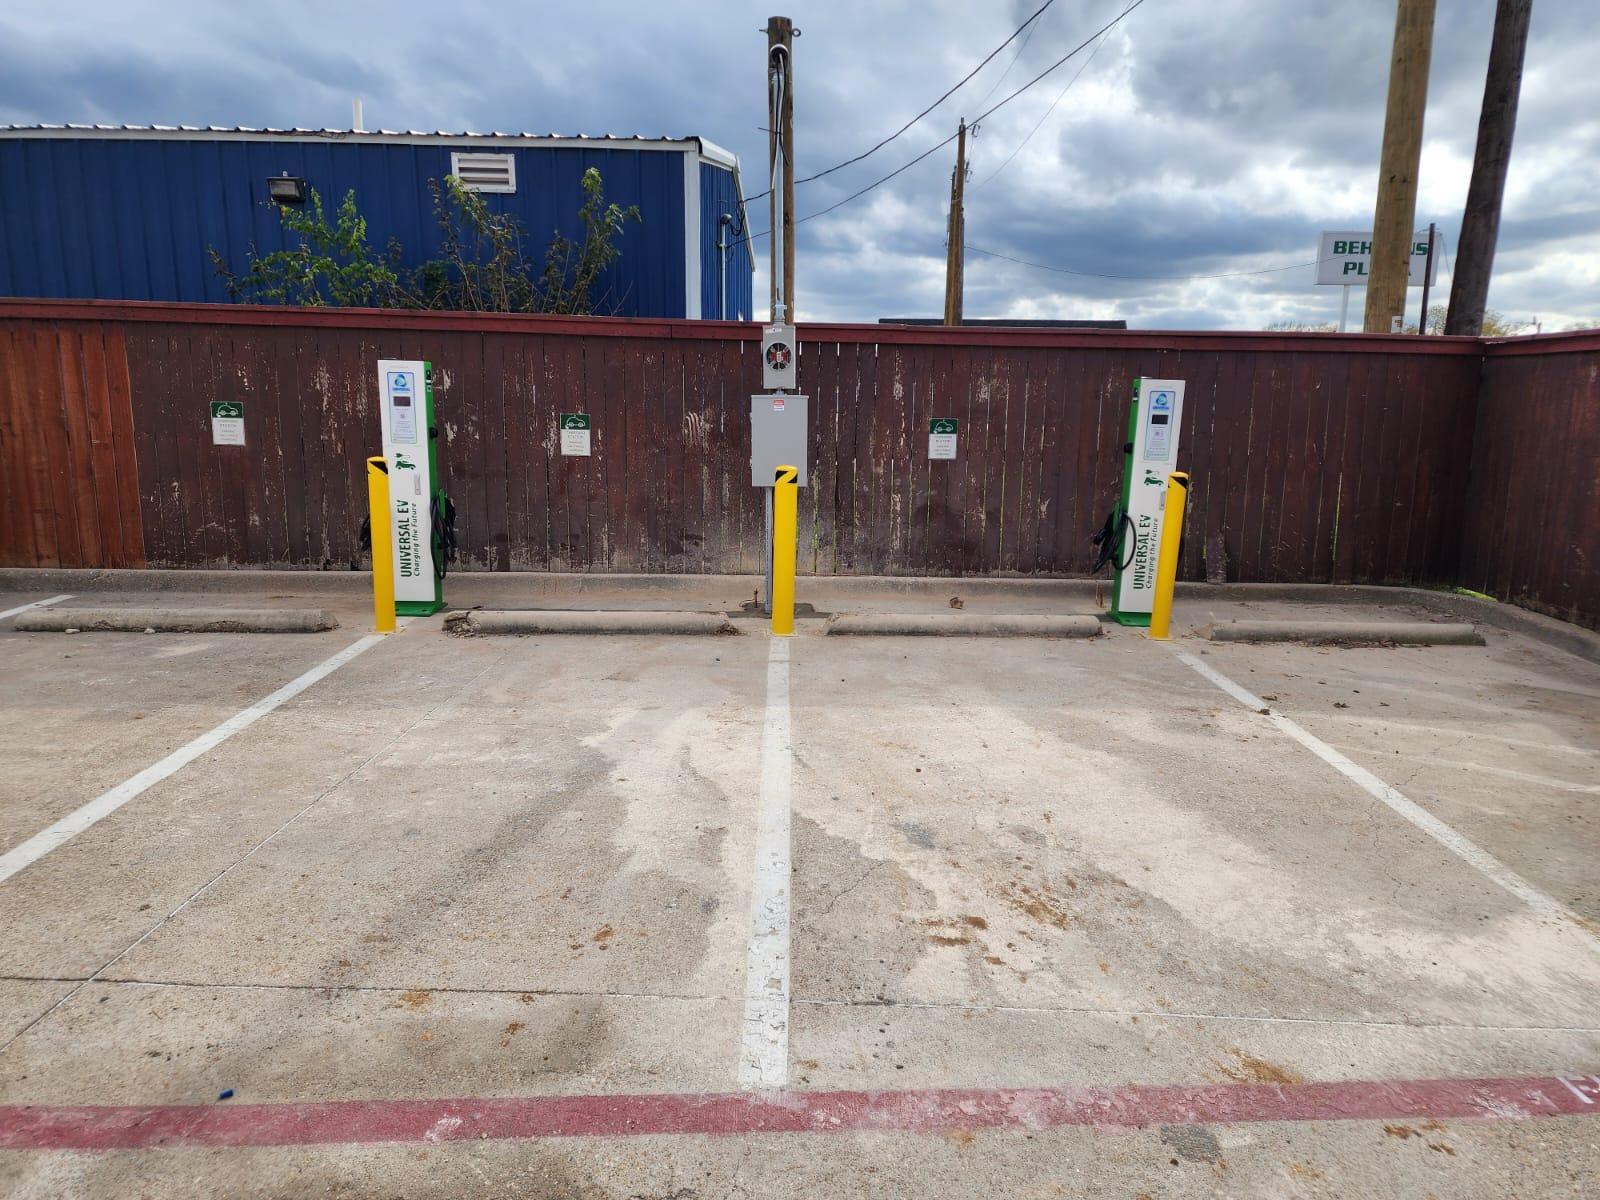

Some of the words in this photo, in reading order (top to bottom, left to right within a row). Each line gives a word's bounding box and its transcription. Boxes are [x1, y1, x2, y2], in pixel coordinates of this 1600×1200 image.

[1333, 240, 1430, 256] BEHS
[396, 499, 409, 514] EV
[1139, 514, 1151, 528] EV
[1150, 518, 1159, 541] Future
[397, 517, 412, 578] UNIVERSAL
[1149, 544, 1157, 555] the
[413, 543, 421, 577] Charging
[1133, 532, 1150, 590] UNIVERSAL
[1145, 557, 1156, 589] Charging
